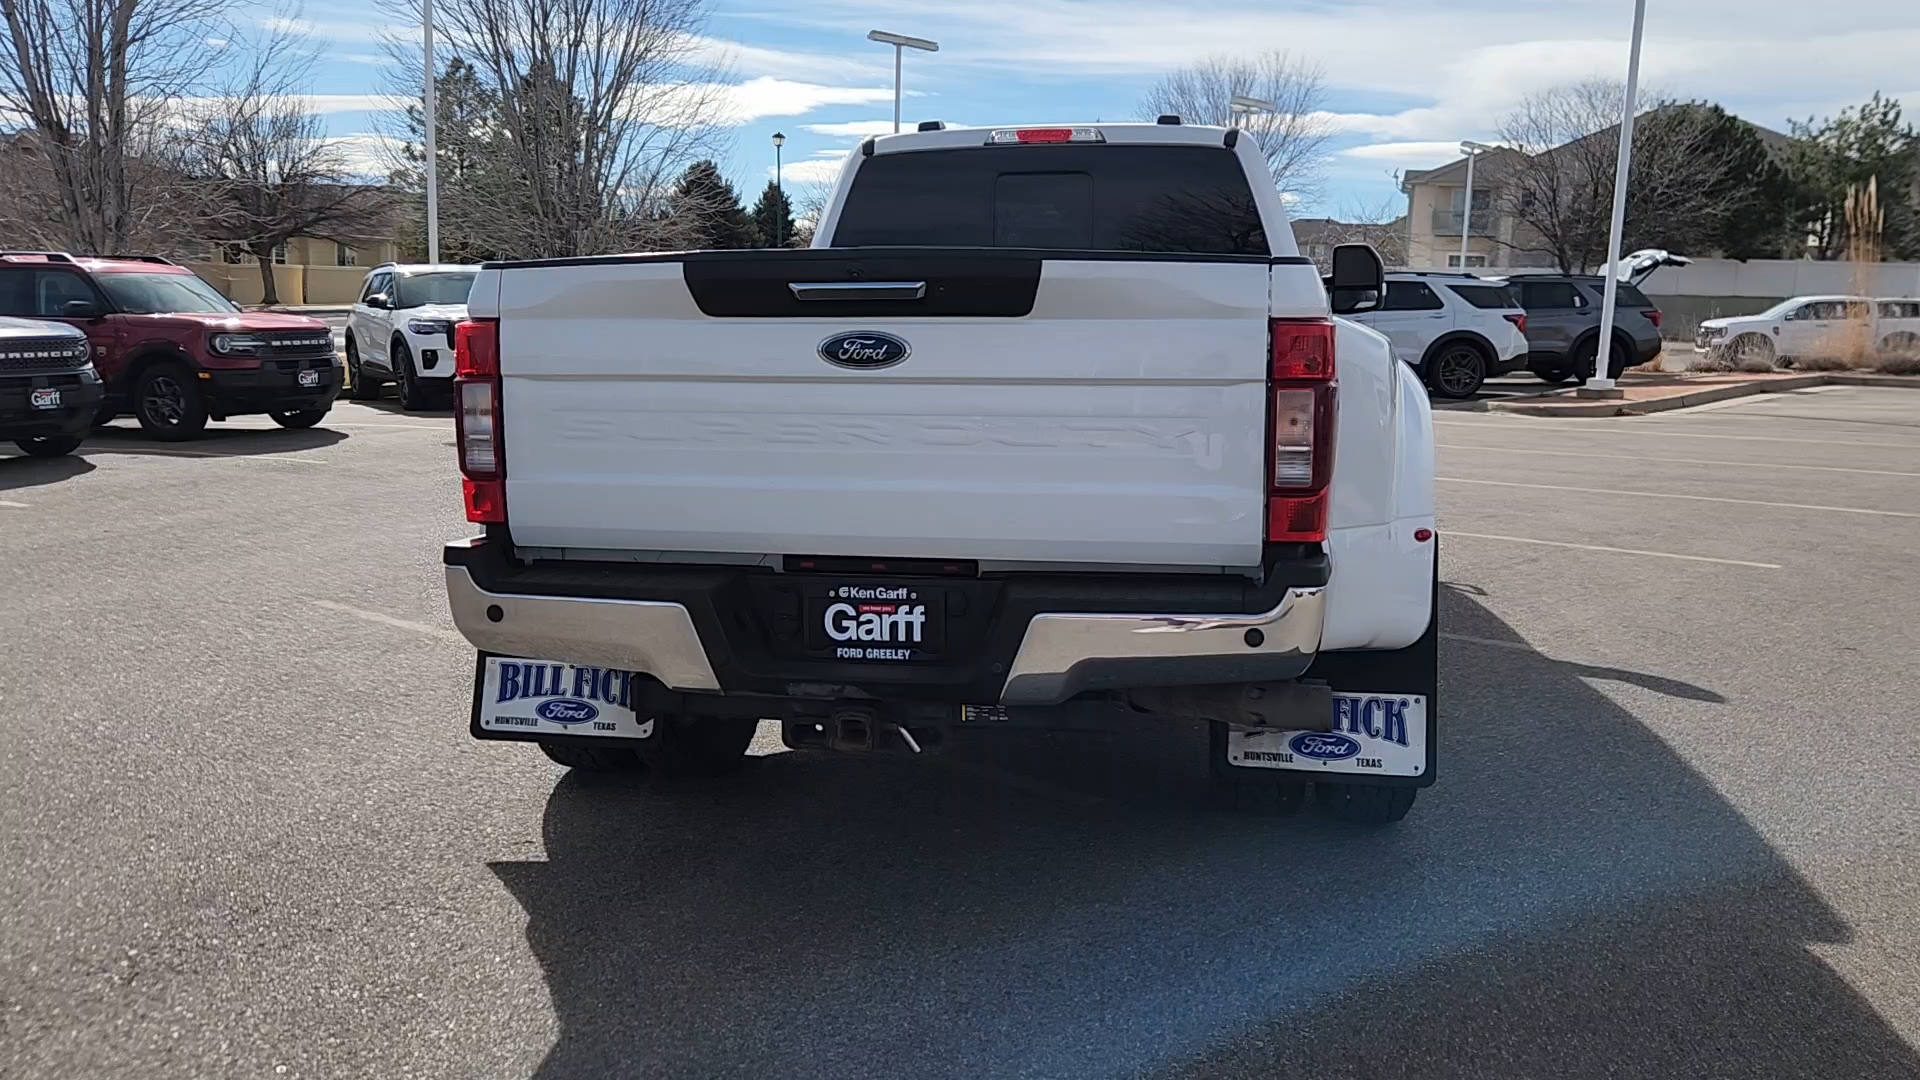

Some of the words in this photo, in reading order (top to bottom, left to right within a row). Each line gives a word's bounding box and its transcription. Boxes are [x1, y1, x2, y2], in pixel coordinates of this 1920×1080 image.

[838, 338, 888, 360] Ford
[298, 372, 319, 384] Garff
[31, 391, 60, 406] Garff
[850, 587, 875, 599] Ken
[876, 587, 908, 600] Garff
[824, 603, 926, 642] Garff
[836, 647, 864, 659] FORD
[866, 648, 911, 660] GREELEY
[496, 662, 566, 704] BILL
[545, 702, 589, 720] Ford
[494, 715, 539, 727] HUNTSVILLE
[593, 721, 617, 732] TEXAS
[1301, 736, 1350, 755] Ford
[1243, 751, 1294, 764] HUNTSVILLE
[1355, 757, 1383, 769] TEXAS
